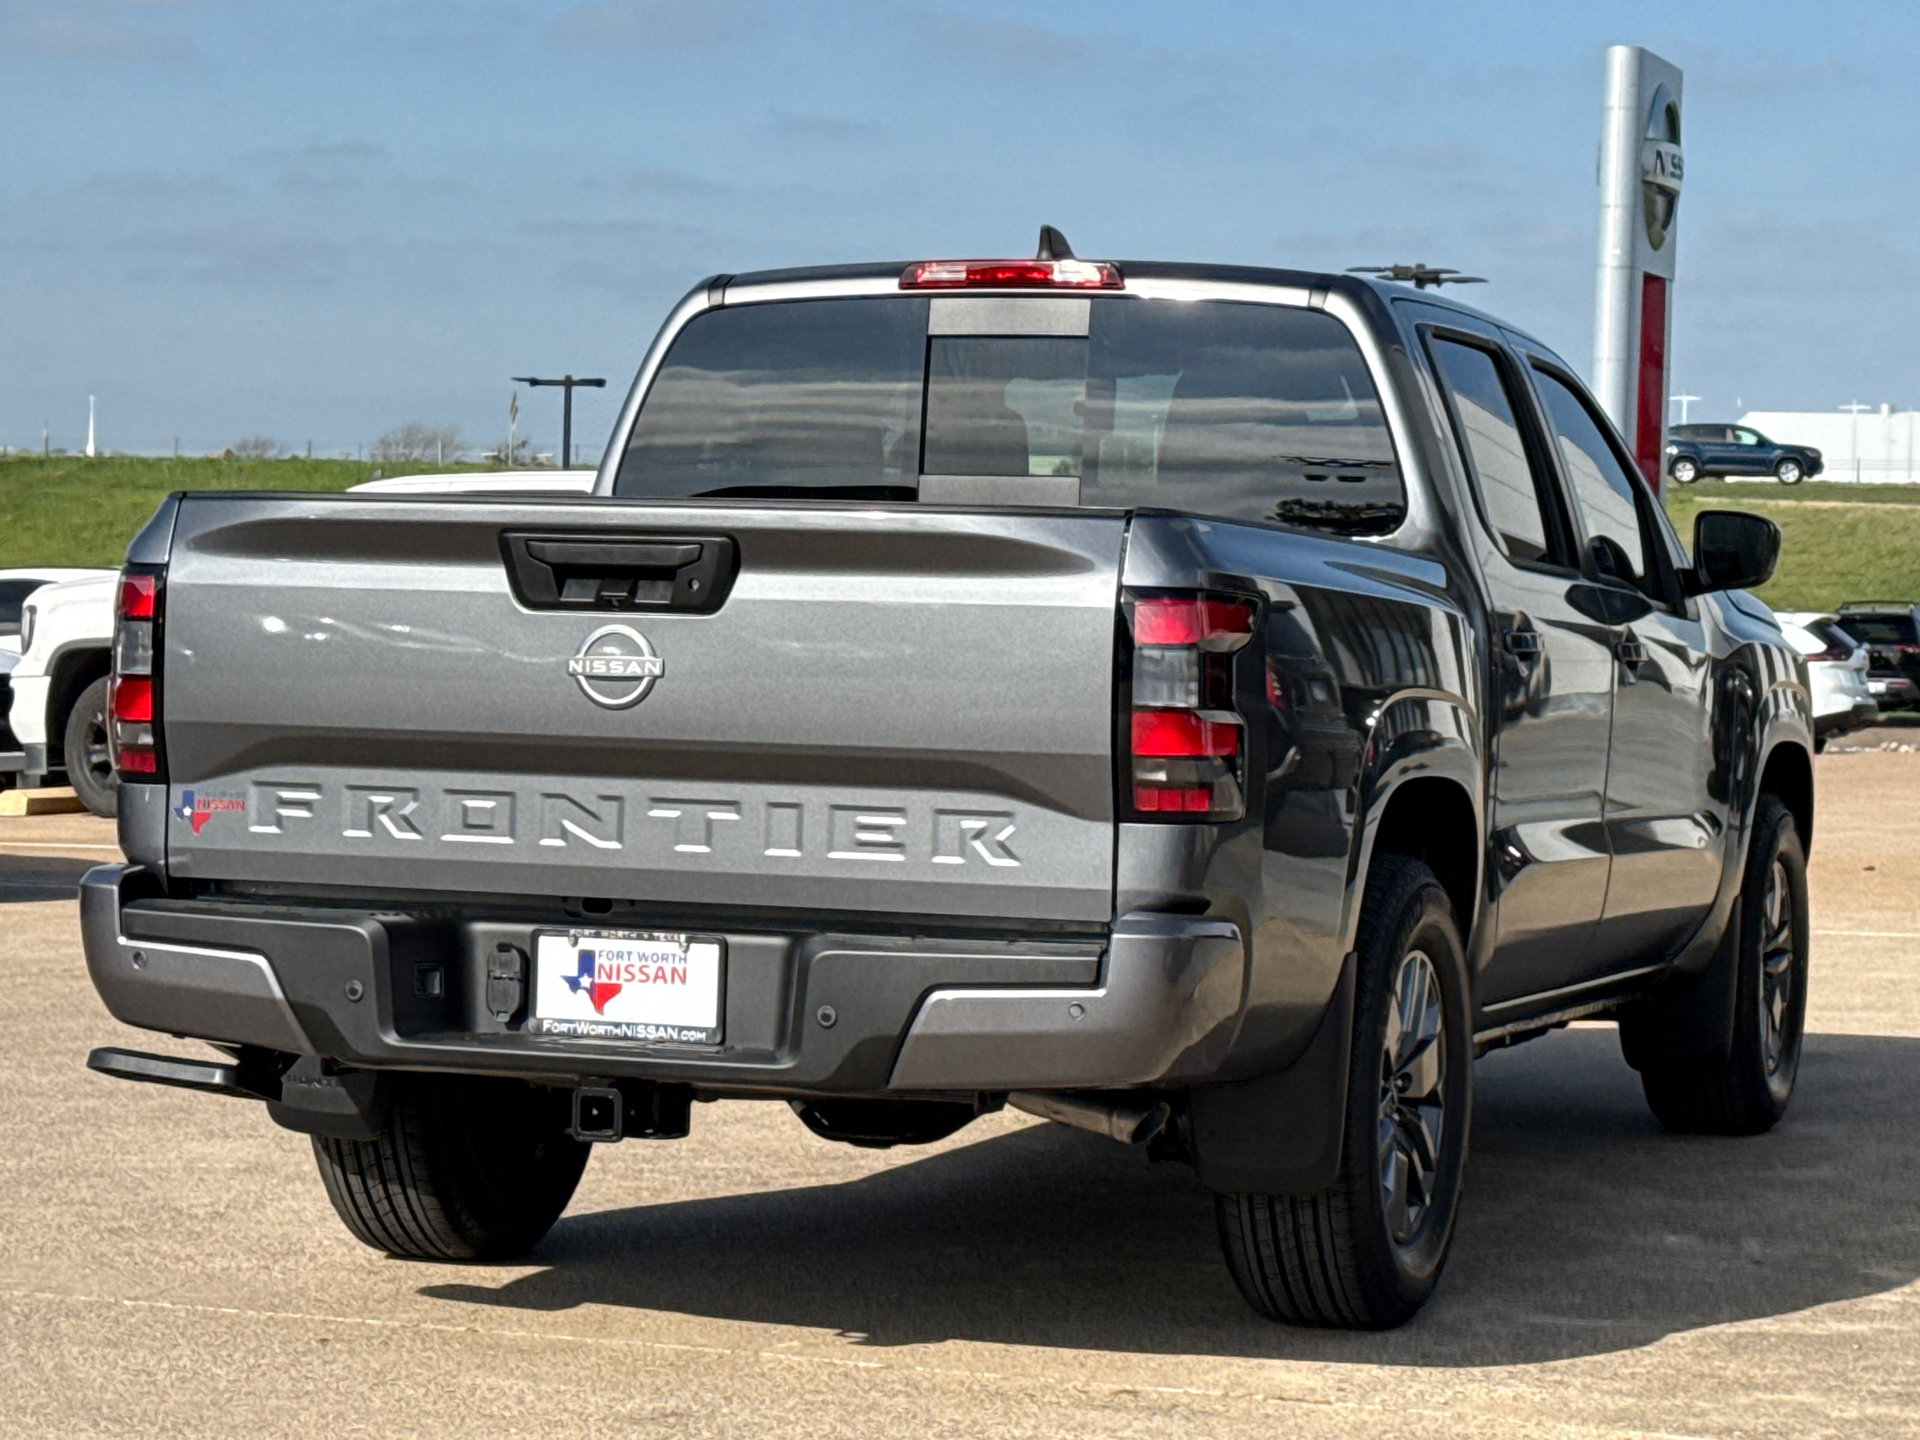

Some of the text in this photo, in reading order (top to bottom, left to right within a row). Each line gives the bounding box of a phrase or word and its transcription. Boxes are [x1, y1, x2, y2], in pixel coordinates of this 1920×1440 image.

[568, 659, 660, 675] NISSAN
[197, 798, 245, 811] NISSAN
[248, 780, 1021, 867] FRONTIER
[598, 949, 687, 965] FORT WORTH
[597, 963, 687, 985] NISSAN
